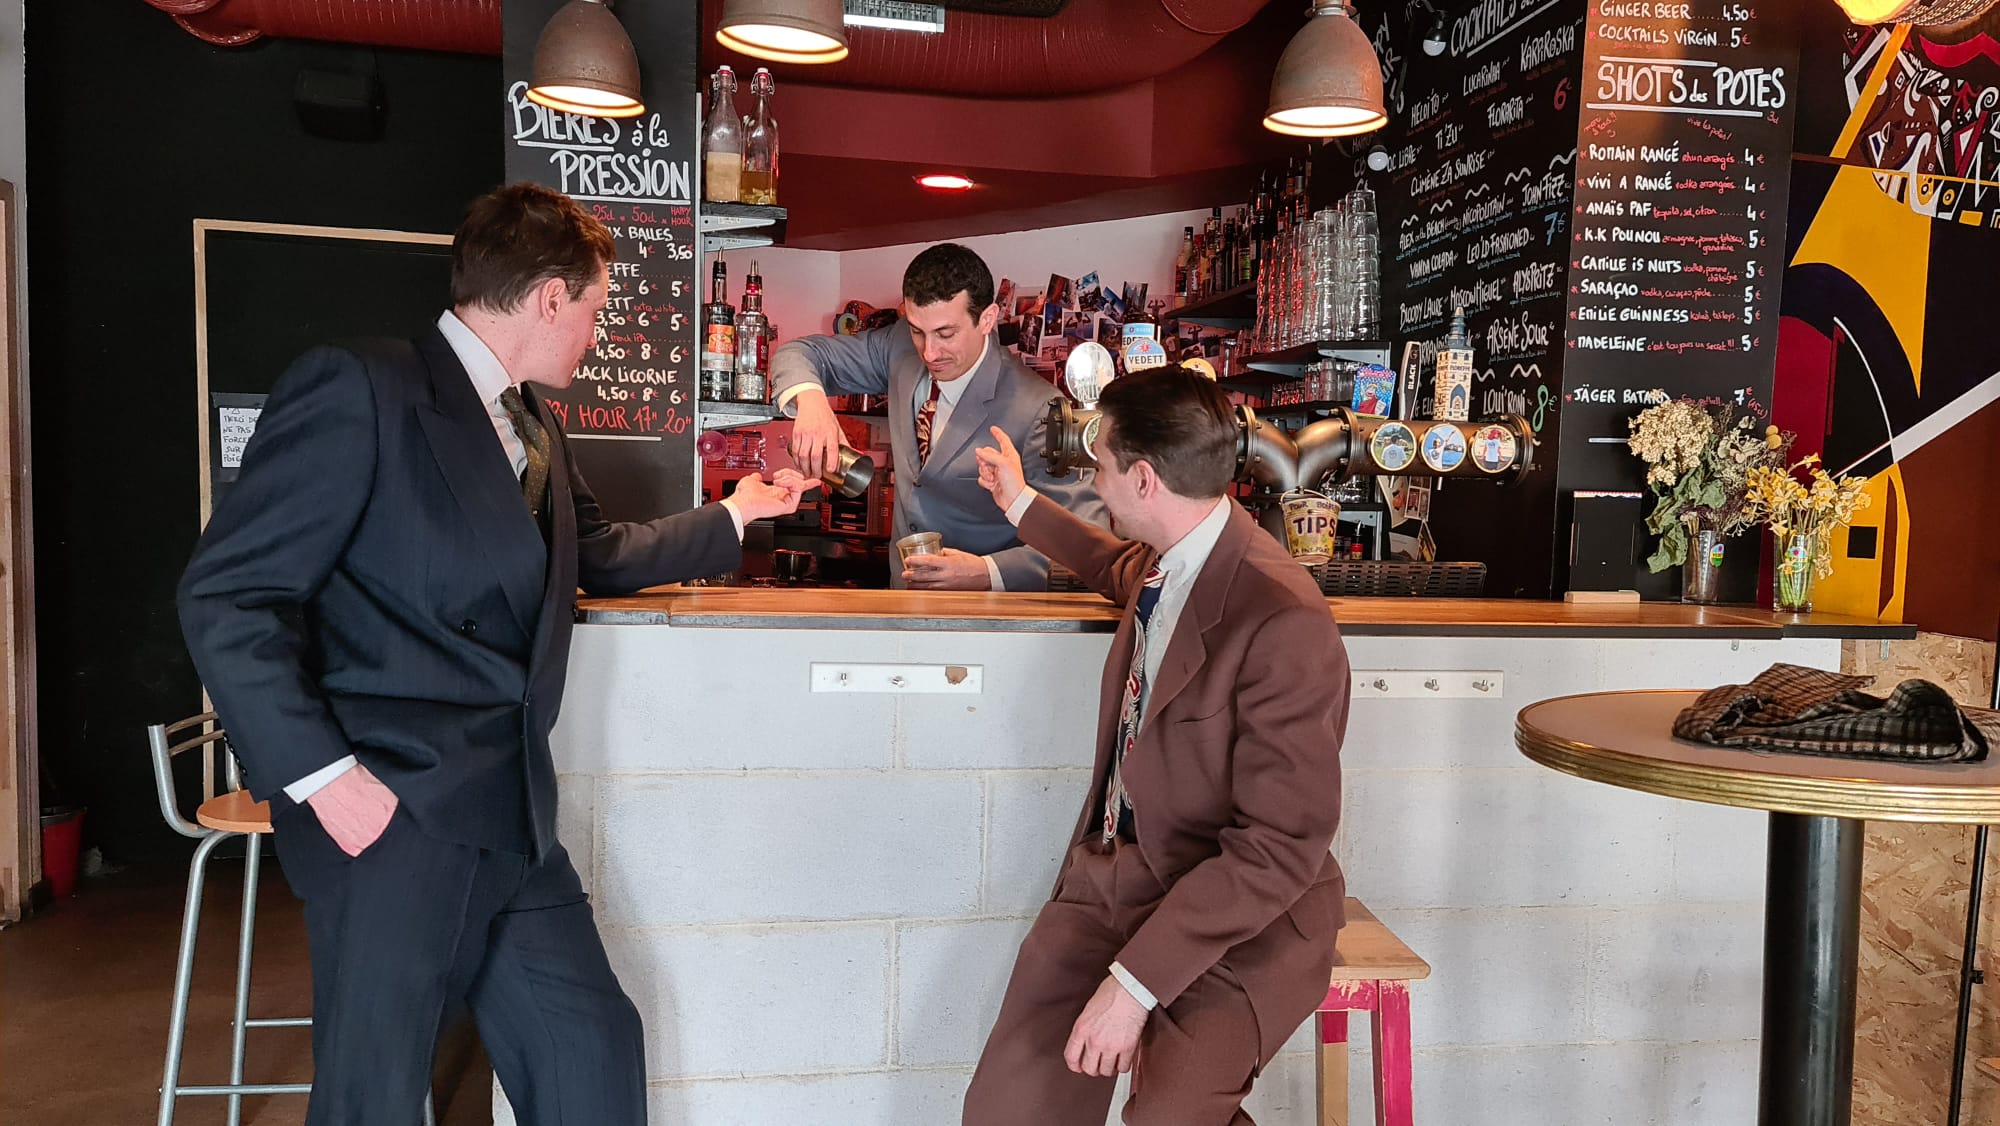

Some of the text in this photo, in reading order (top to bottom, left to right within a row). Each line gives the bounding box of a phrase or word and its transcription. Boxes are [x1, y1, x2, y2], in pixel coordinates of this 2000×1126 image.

[1654, 3, 1692, 20] BEER
[1597, 62, 1688, 104] SHOTS
[1689, 79, 1708, 103] des
[1712, 66, 1786, 109] POTES
[632, 120, 643, 147] à
[649, 113, 670, 148] la
[1640, 140, 1679, 162] RANGÉ
[1619, 175, 1628, 190] A
[1635, 171, 1673, 190] RANGÉ
[670, 207, 691, 216] HAPPY
[1630, 200, 1652, 216] PAF
[671, 217, 693, 227] HOUR
[628, 226, 673, 242] BALLES
[1612, 226, 1661, 243] POUNOU
[1648, 258, 1682, 273] NUTS
[1580, 278, 1638, 300] SARAÇAO
[1520, 310, 1549, 352] SOUR
[1128, 355, 1163, 364] VEDETT
[572, 365, 613, 382] LACK
[1407, 364, 1417, 390] BLACK
[1573, 384, 1616, 402] JÄGER
[579, 403, 631, 431] HOUR
